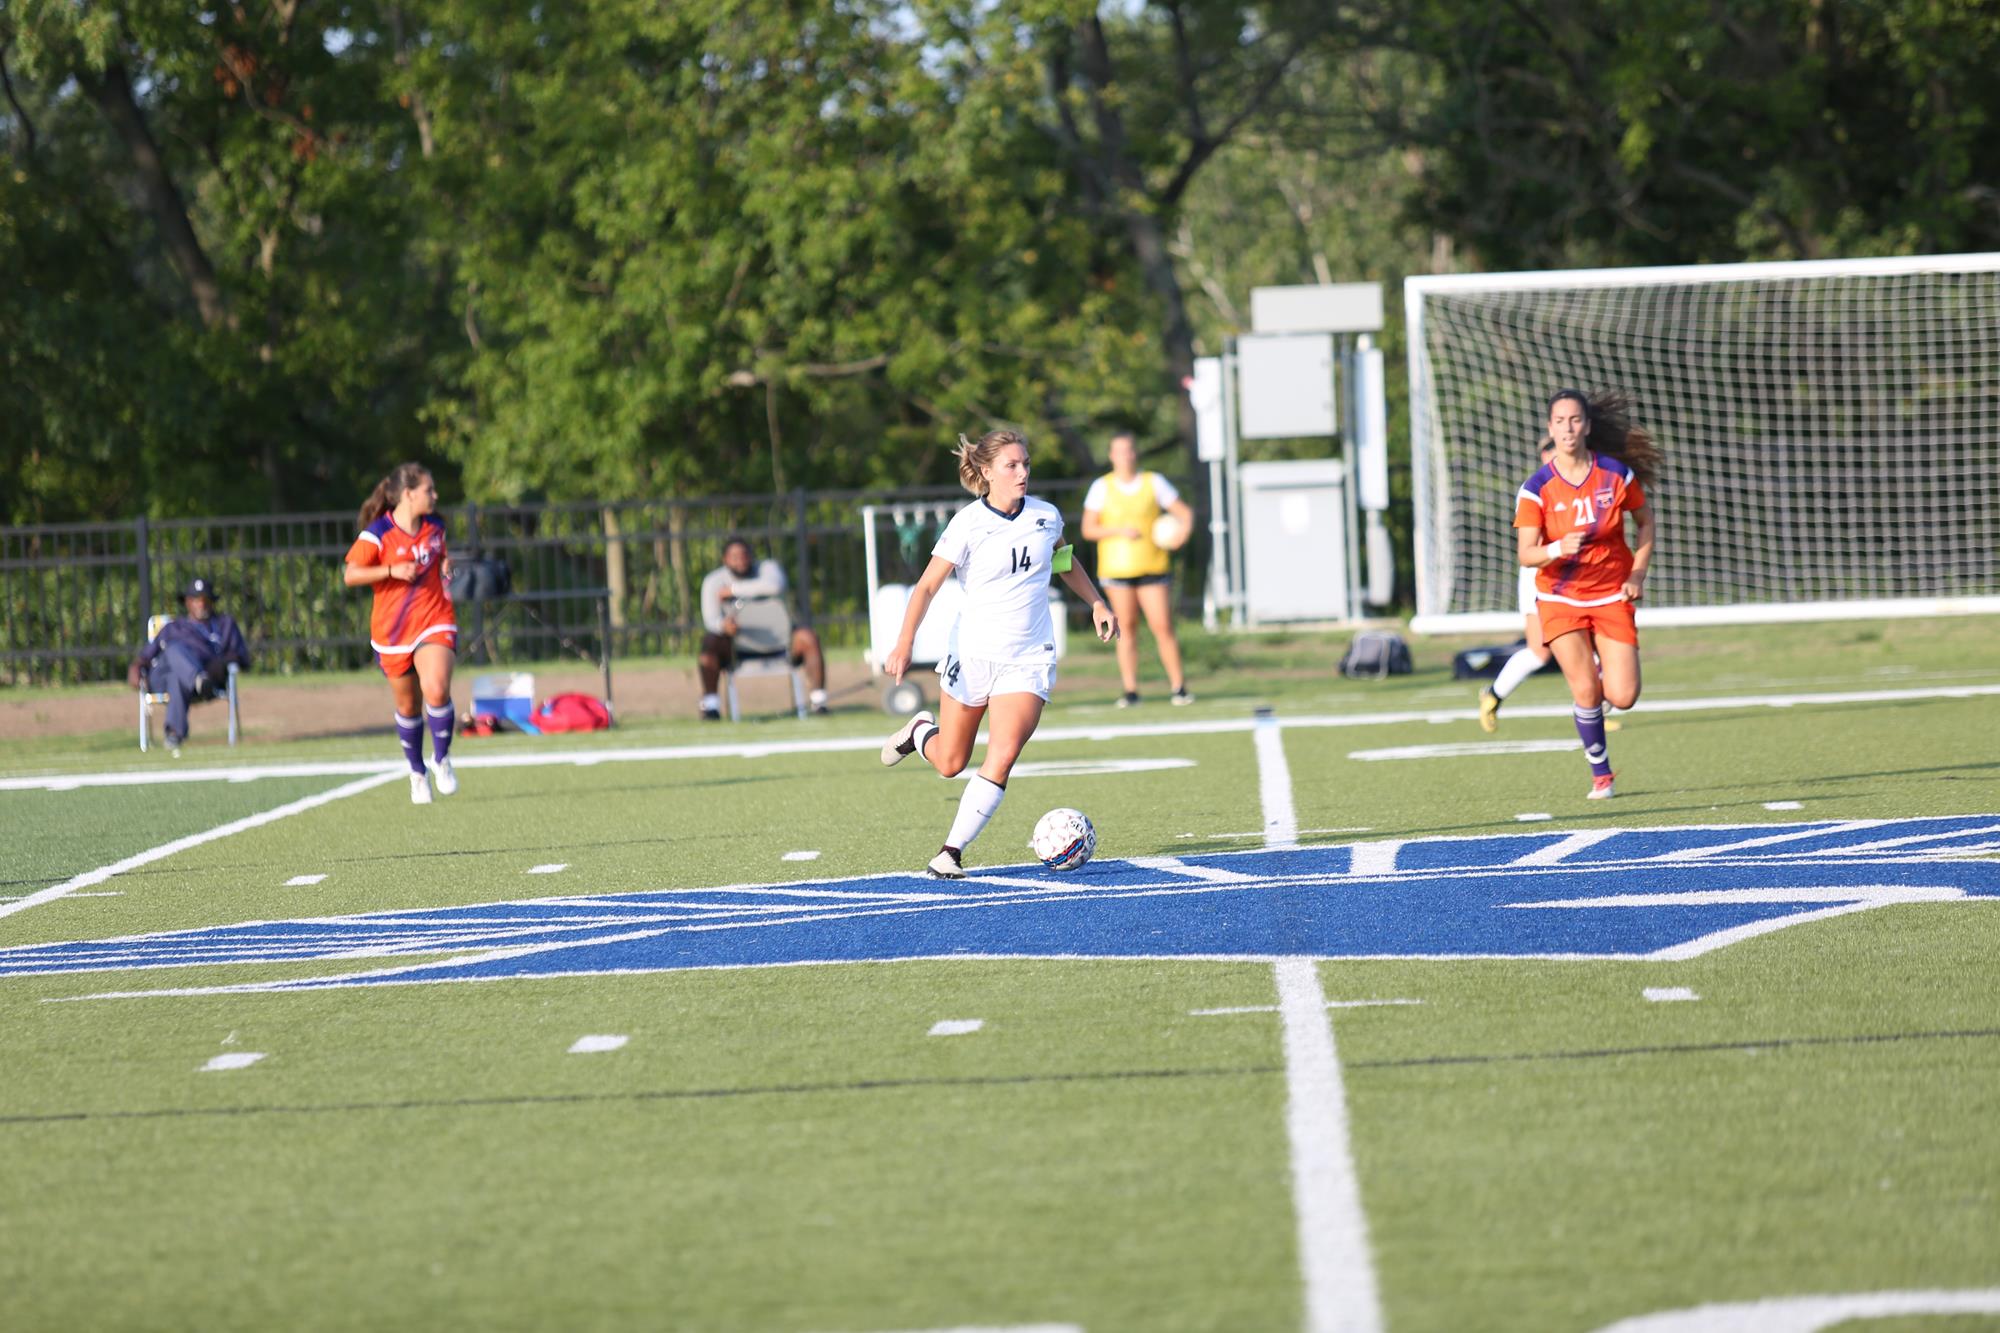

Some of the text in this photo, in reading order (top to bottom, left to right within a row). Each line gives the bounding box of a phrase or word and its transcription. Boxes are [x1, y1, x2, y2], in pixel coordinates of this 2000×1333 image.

[1572, 496, 1596, 526] 21
[1011, 546, 1031, 574] 14
[942, 654, 961, 687] 14
